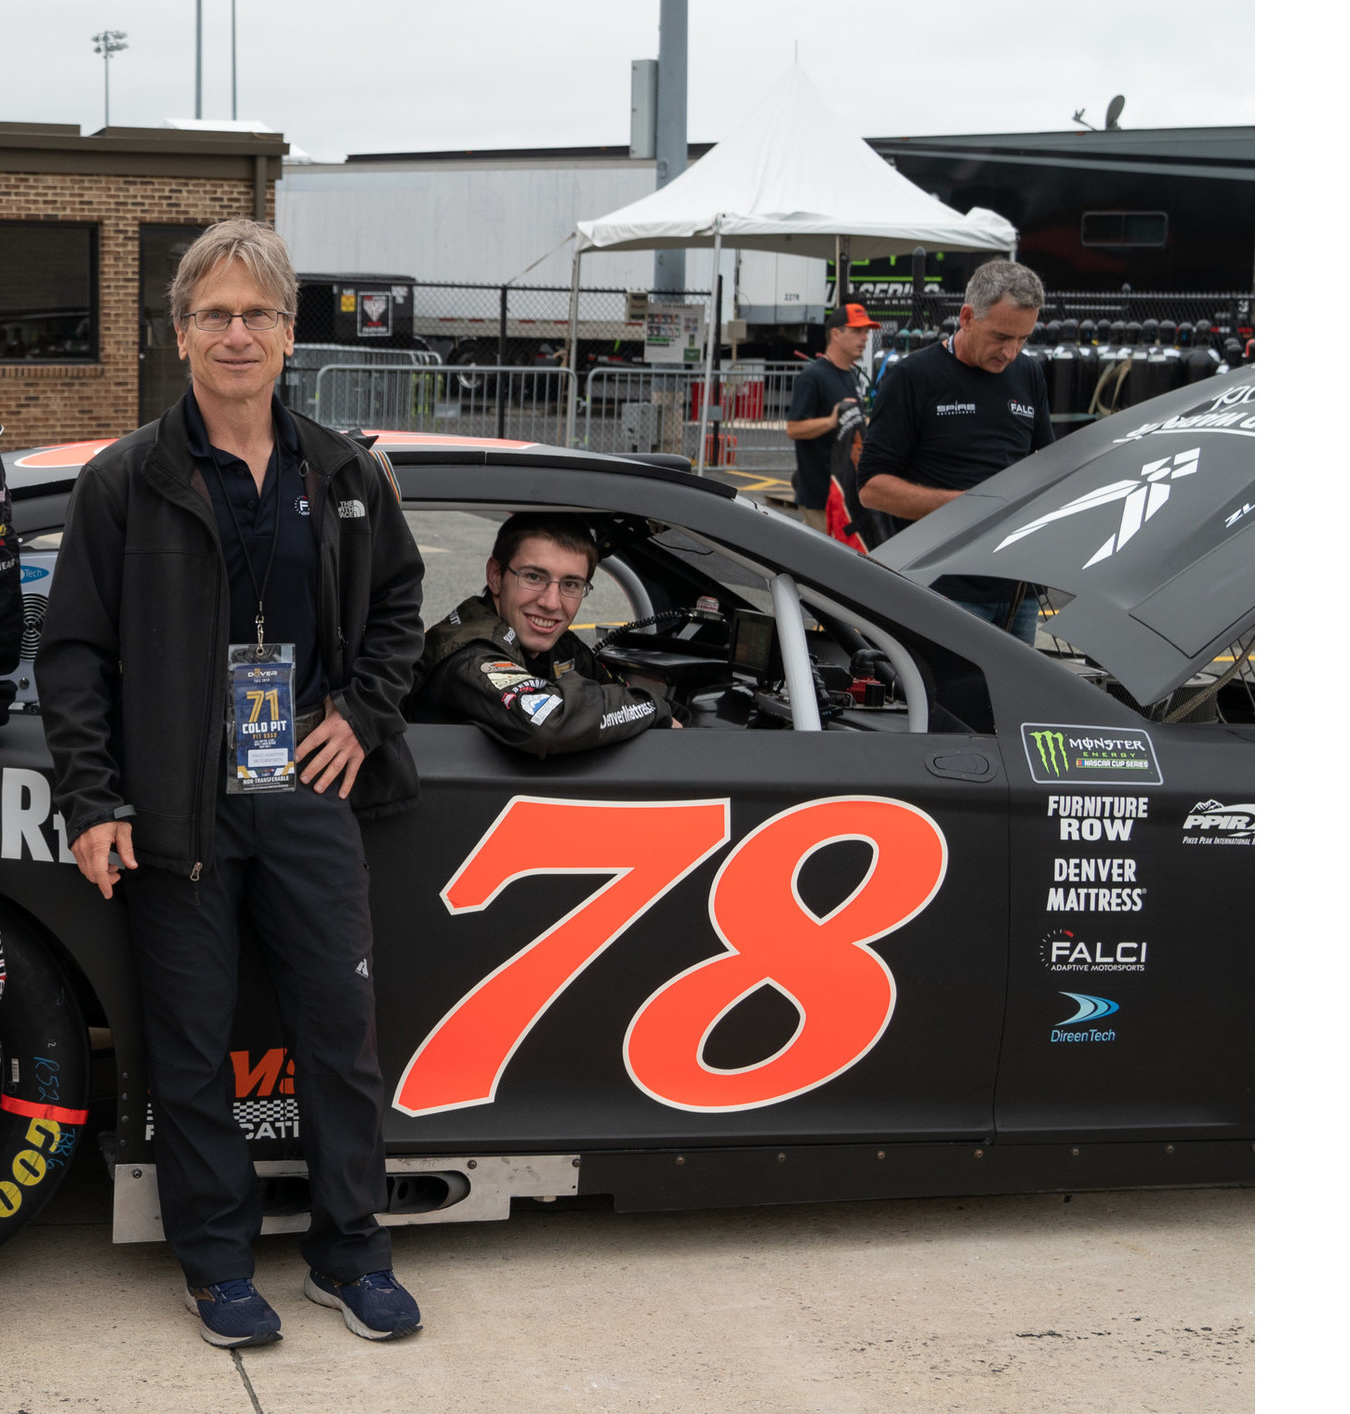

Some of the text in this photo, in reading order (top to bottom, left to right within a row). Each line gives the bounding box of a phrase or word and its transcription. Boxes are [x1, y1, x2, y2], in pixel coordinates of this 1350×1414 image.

[246, 689, 279, 722] 71
[242, 720, 287, 734] COLD PIT
[1069, 737, 1146, 751] MONSTER
[1084, 759, 1111, 767] NASCAR
[1126, 760, 1149, 768] SERIES
[1047, 795, 1149, 818] FURNITURE
[1060, 818, 1134, 841] ROW
[1182, 814, 1251, 830] PPIR
[1199, 836, 1215, 845] PEAK
[1053, 858, 1137, 882] DENVER
[1046, 887, 1143, 912] MATTRESS
[391, 794, 949, 1118] 78
[1051, 942, 1147, 962] FALCI
[1051, 964, 1145, 972] ADAPTIVE MOTORSPORTS
[1050, 1029, 1116, 1043] DireenTech
